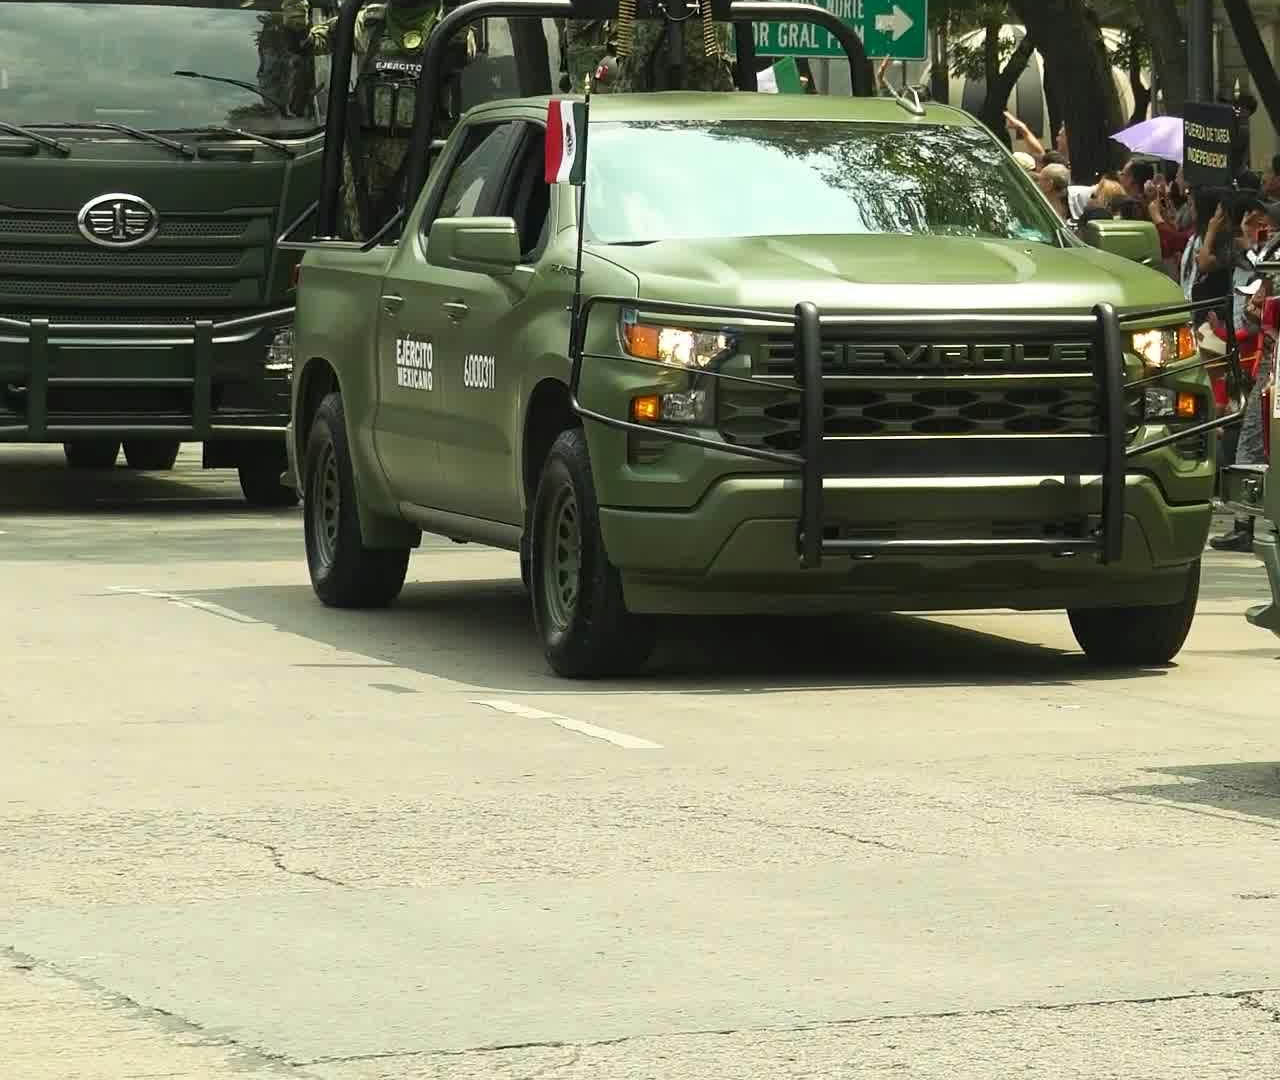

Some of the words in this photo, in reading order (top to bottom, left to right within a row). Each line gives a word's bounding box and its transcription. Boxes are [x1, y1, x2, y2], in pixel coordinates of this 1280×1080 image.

[778, 22, 819, 49] GRAL
[396, 333, 433, 370] EJÉRCITO
[397, 366, 433, 391] MEXICANO
